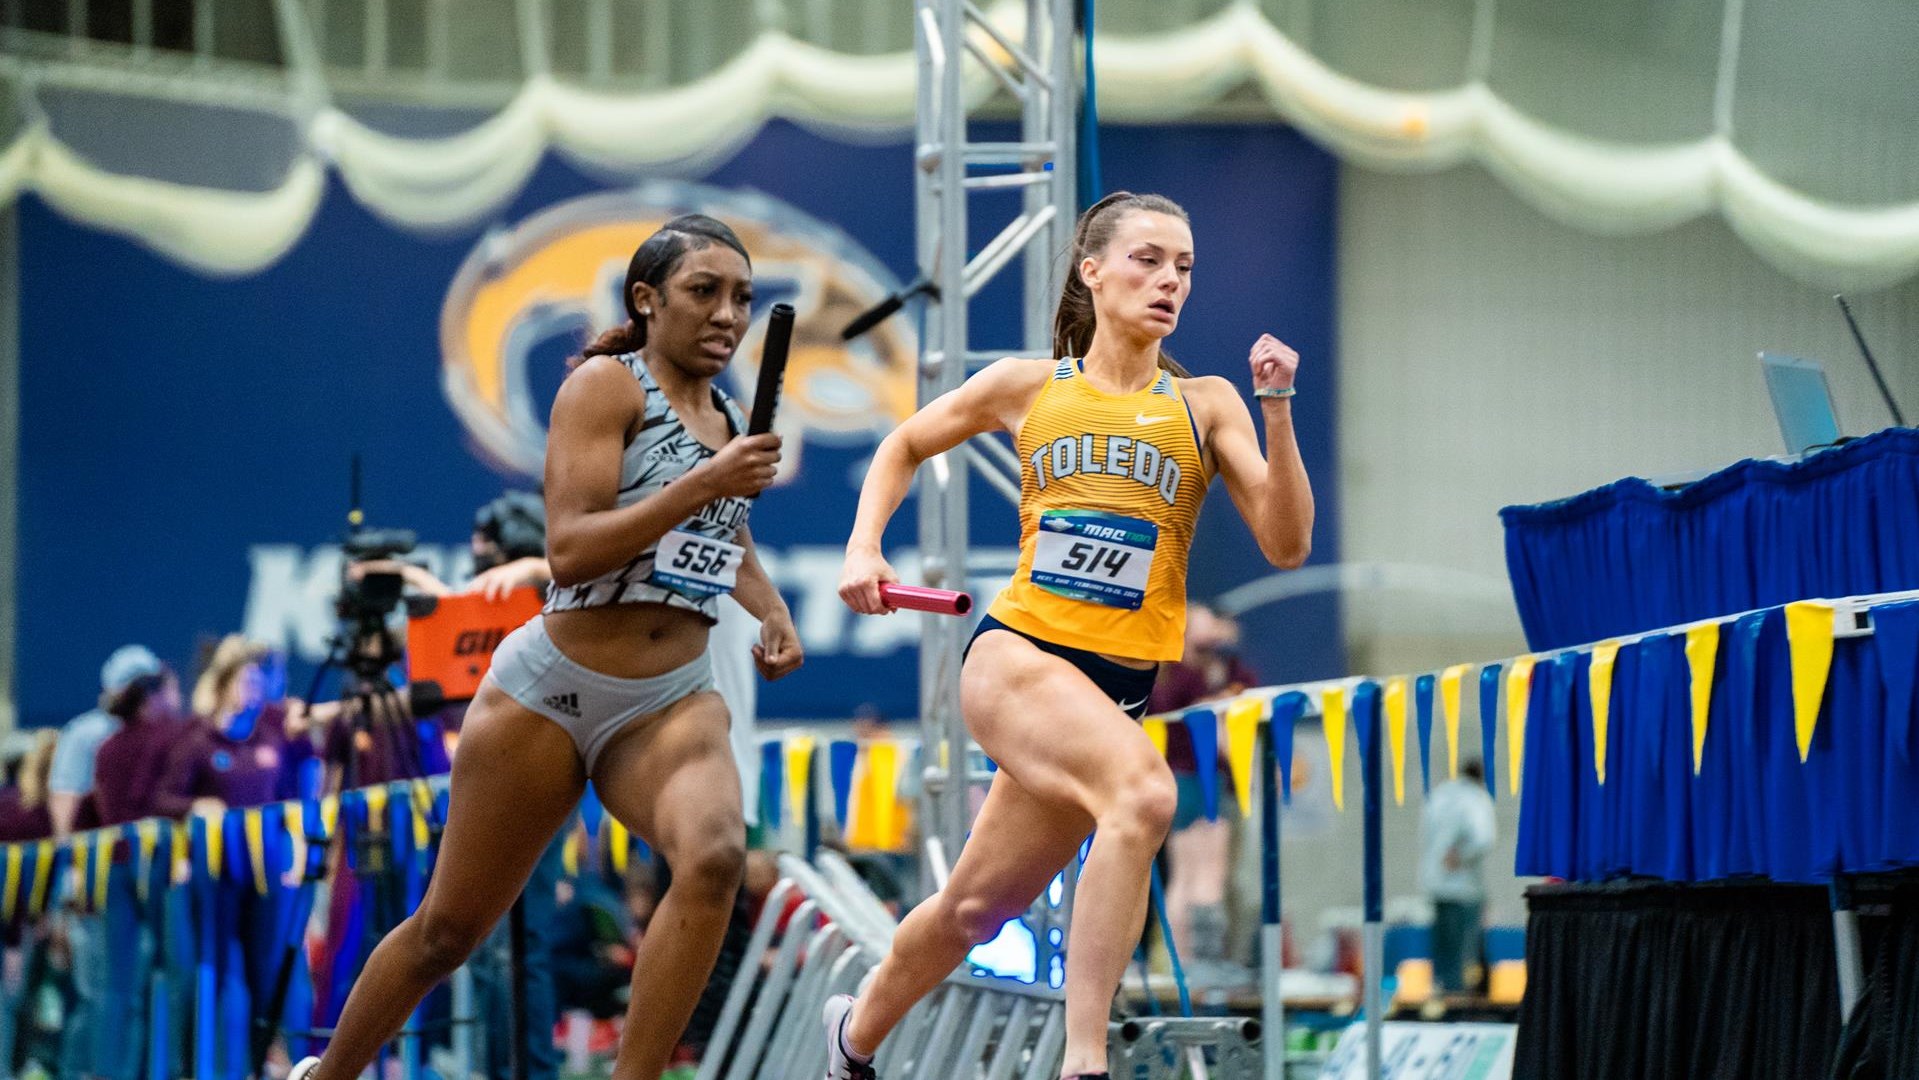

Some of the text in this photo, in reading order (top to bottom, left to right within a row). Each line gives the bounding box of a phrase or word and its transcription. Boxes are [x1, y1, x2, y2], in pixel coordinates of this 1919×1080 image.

[1030, 433, 1181, 506] TOLEDO
[672, 540, 732, 576] 556
[1061, 542, 1132, 577] 514
